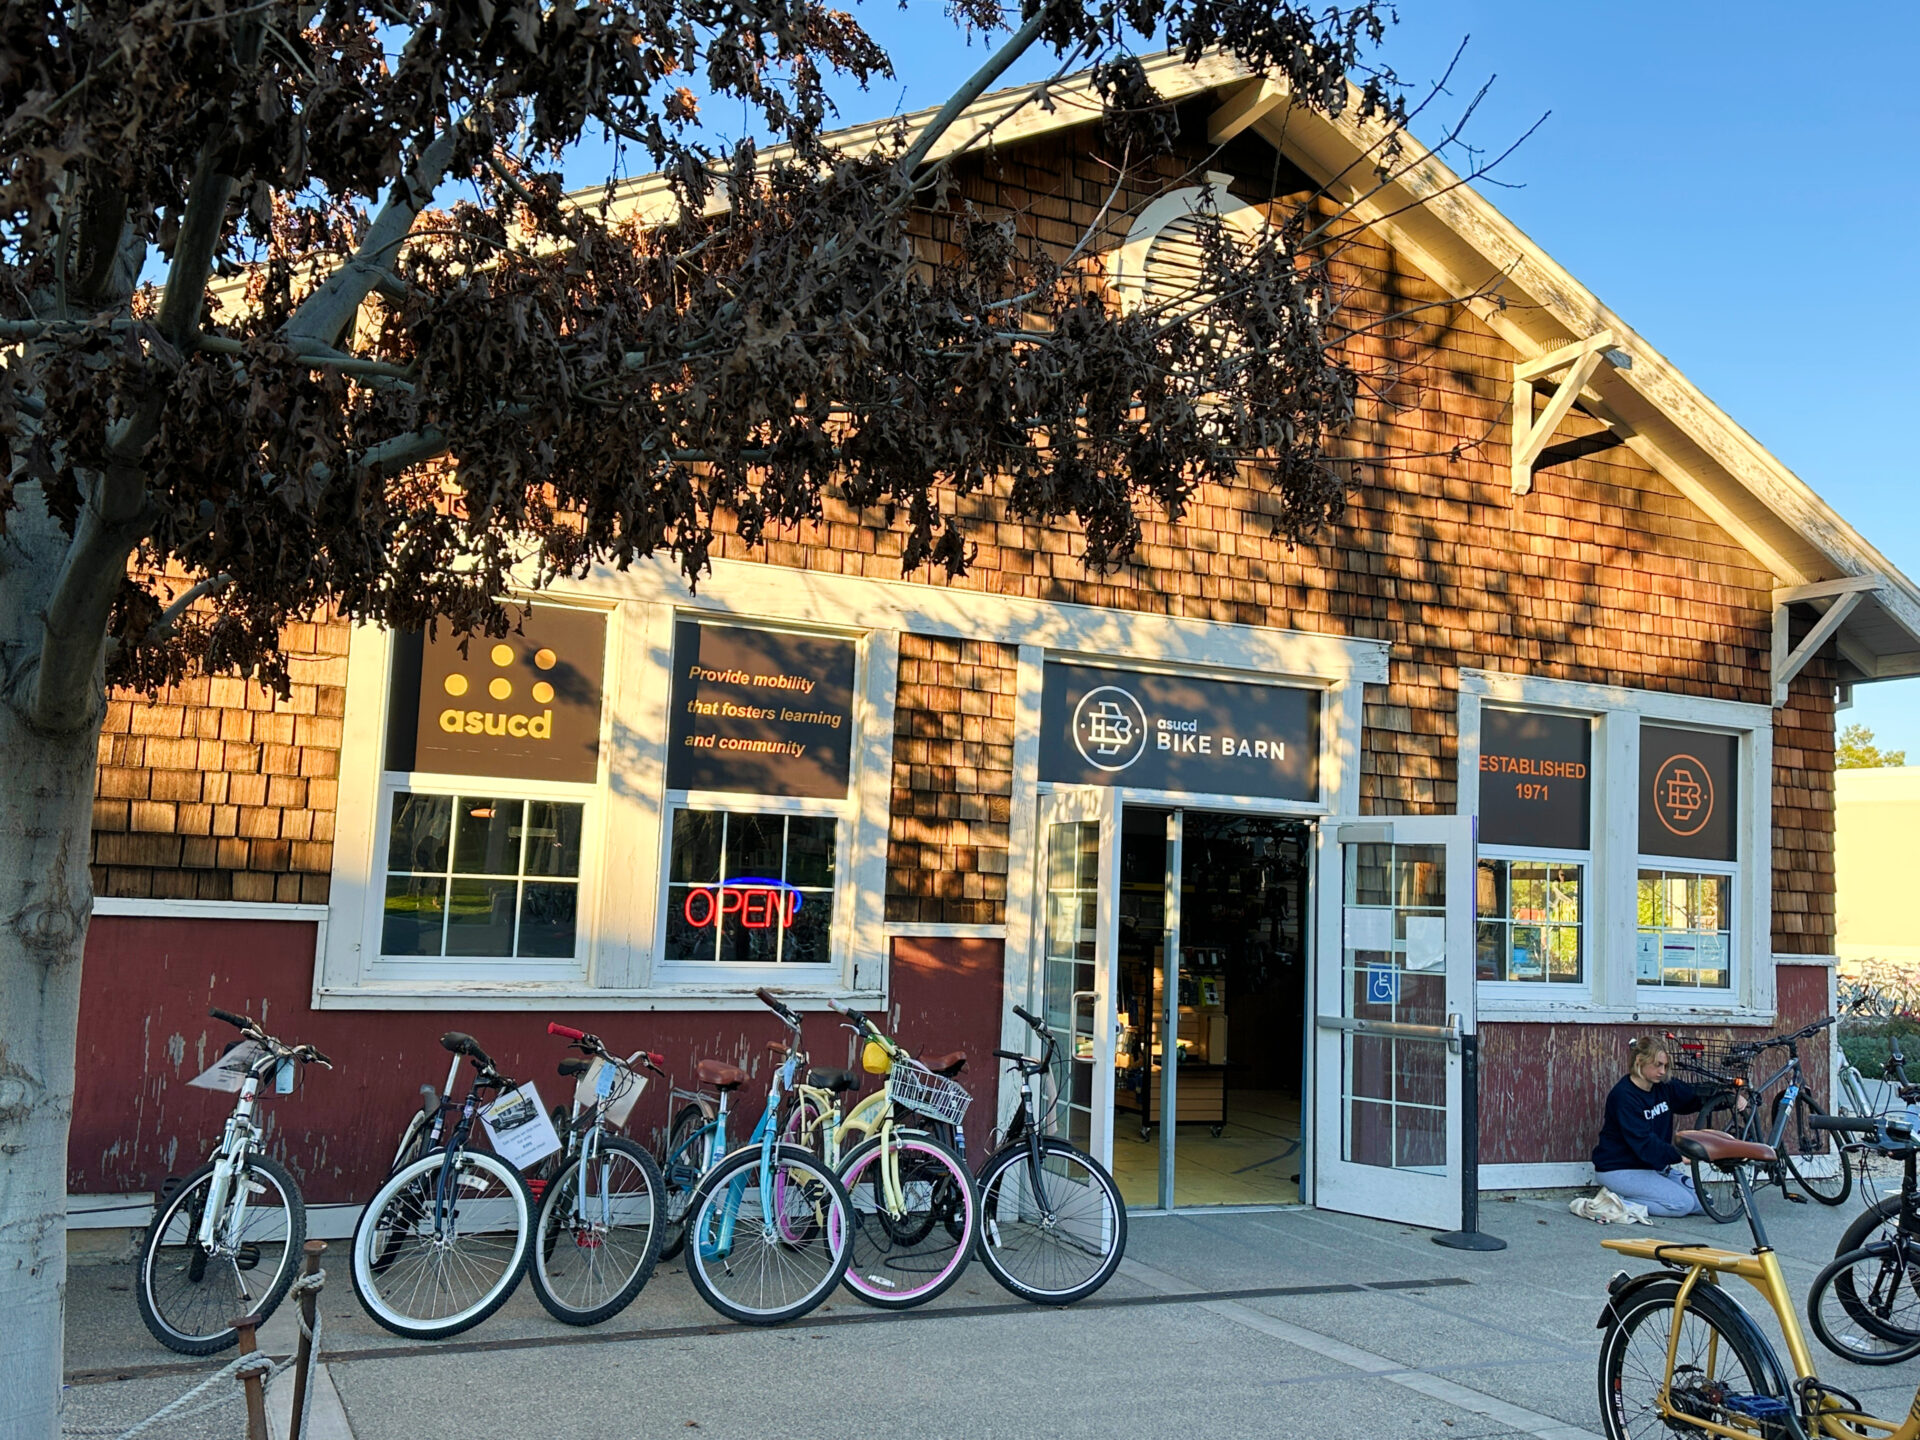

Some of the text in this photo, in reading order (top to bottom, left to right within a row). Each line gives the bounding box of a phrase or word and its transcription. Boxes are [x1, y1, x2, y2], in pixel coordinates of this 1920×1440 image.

[688, 665, 816, 694] Provide mobility
[439, 709, 552, 739] asucd
[687, 699, 842, 728] that fosters learning
[1157, 718, 1198, 733] asucd
[684, 734, 806, 758] and community
[1157, 731, 1285, 761] BIKE BARN
[1479, 754, 1587, 780] ESTABLISHED
[1515, 783, 1549, 801] 1971
[684, 888, 795, 928] OPEN
